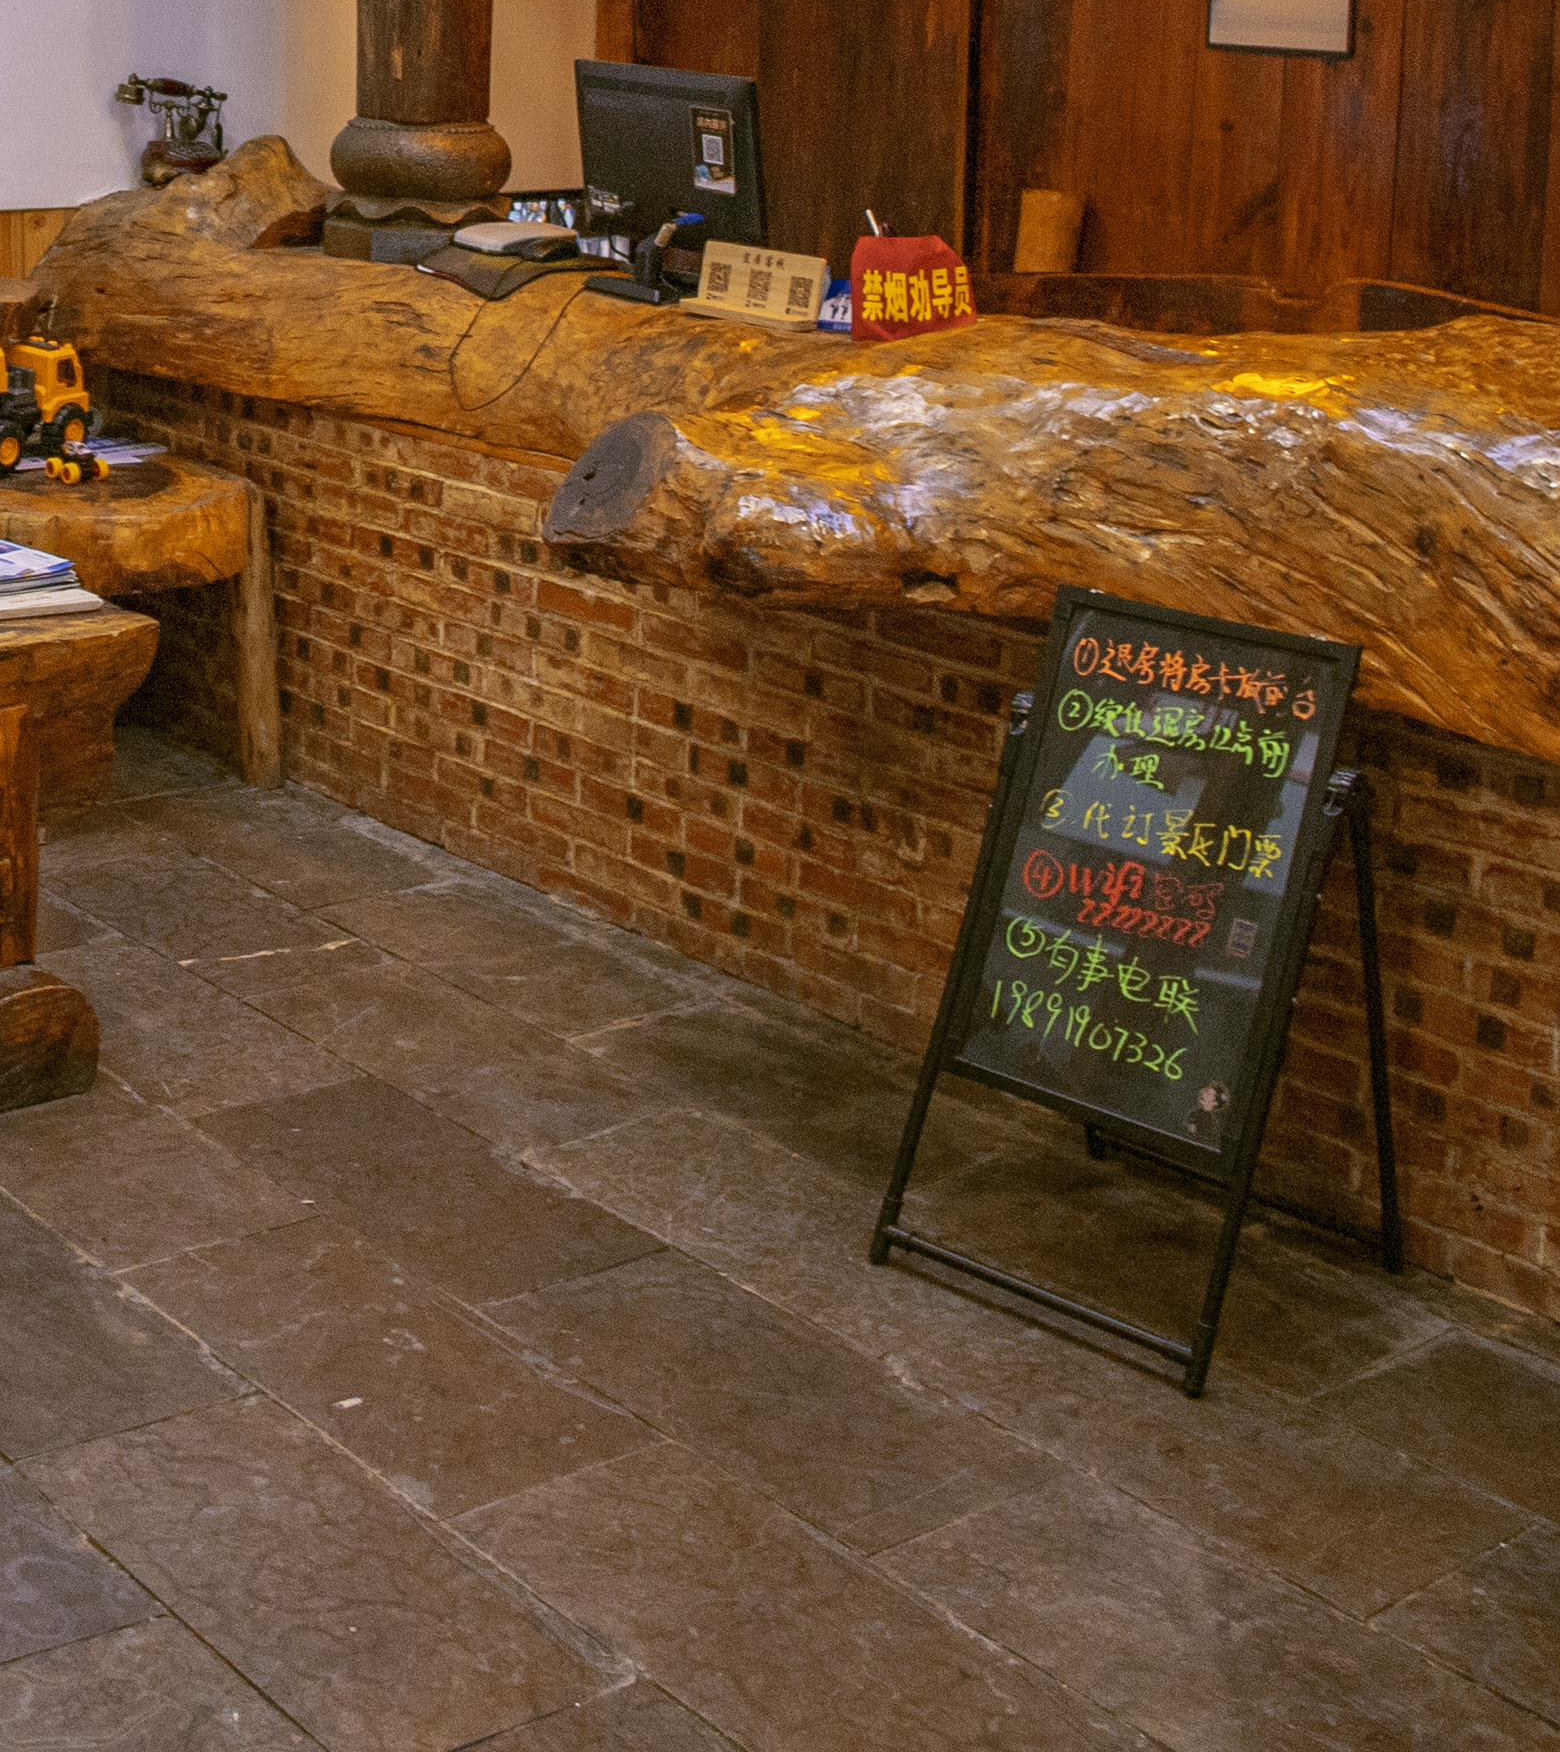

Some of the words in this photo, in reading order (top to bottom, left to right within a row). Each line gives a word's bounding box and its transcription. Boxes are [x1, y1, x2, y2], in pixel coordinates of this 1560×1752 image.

[861, 265, 972, 323] 禁烟劝导员
[991, 980, 1188, 1080] 19891907326
